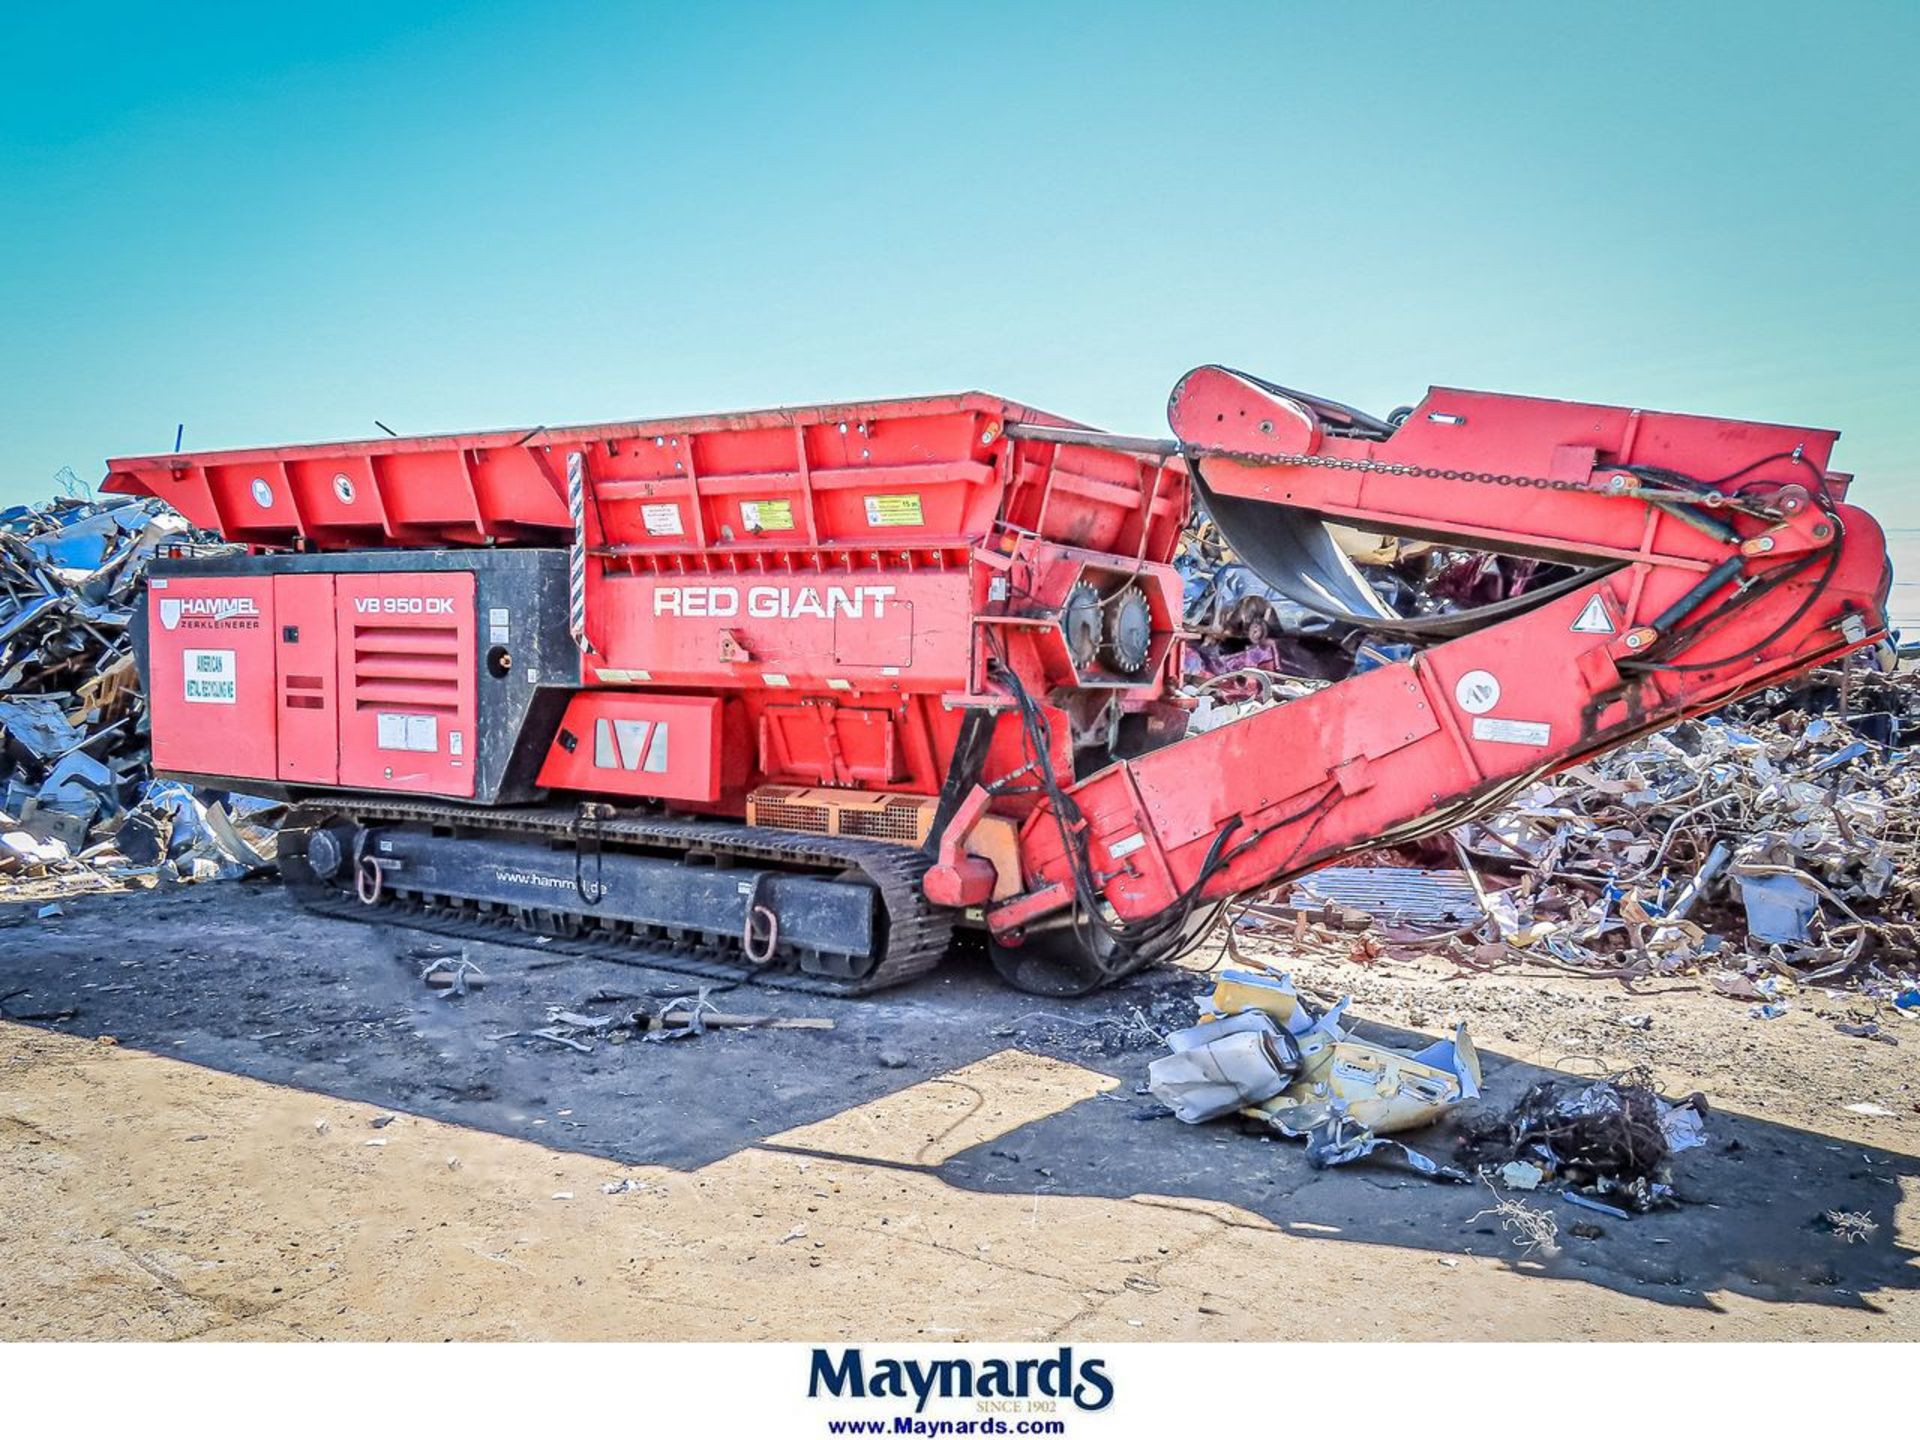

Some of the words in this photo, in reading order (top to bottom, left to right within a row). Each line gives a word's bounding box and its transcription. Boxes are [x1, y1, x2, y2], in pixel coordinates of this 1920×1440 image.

[181, 598, 259, 614] HAMMEL
[383, 598, 422, 613] 950
[425, 598, 455, 614] DK
[654, 587, 739, 617] RED
[747, 586, 896, 618] GIANT
[181, 621, 259, 629] ZERKLEINERER
[496, 871, 607, 895] www.hamml.de
